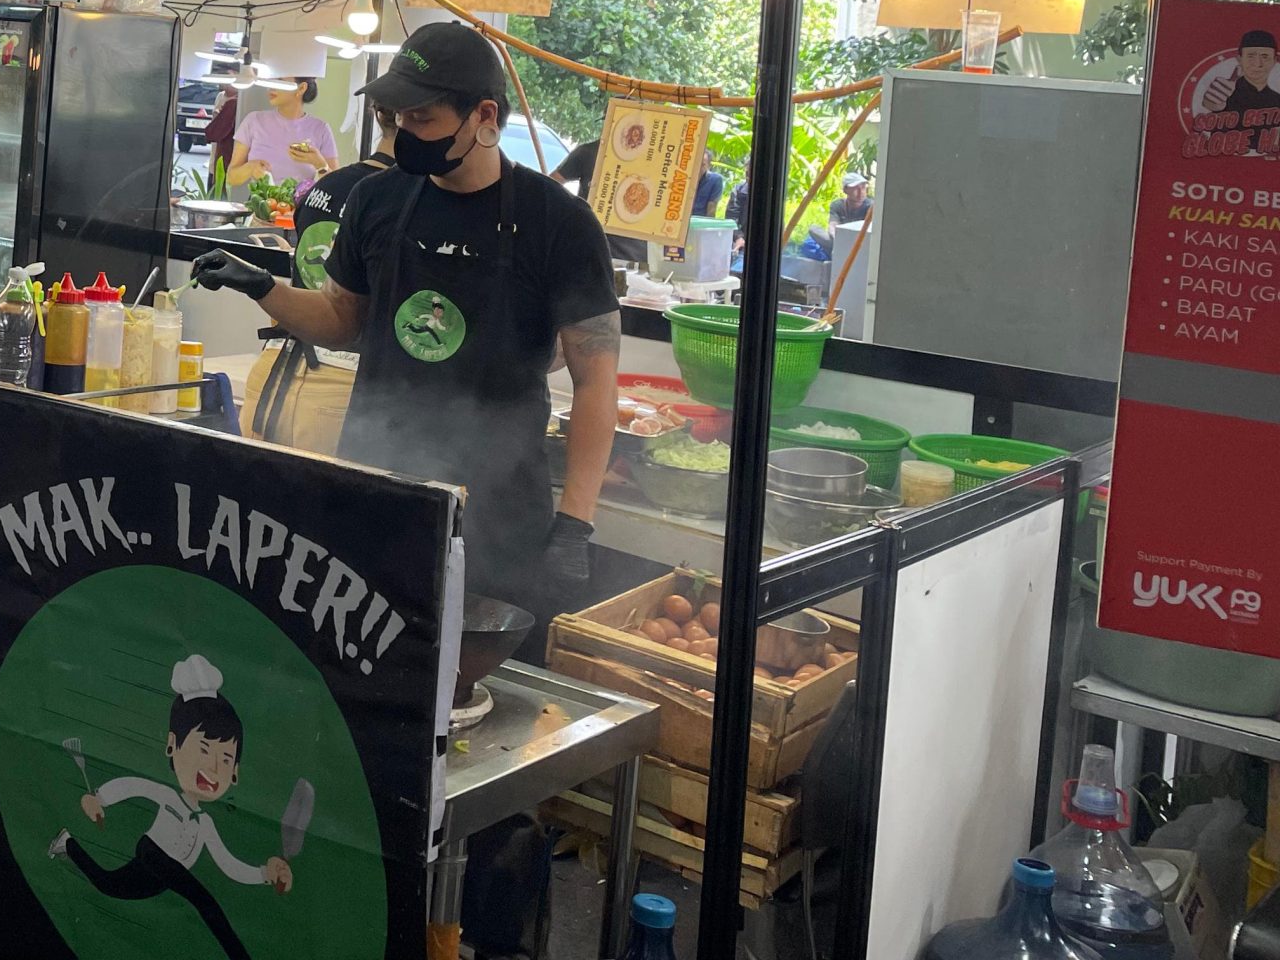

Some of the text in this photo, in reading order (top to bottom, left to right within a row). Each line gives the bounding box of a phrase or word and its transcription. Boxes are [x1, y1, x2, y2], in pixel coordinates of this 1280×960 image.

[687, 119, 699, 143] Nasi
[1193, 111, 1240, 132] SOTO
[1182, 129, 1255, 158] GLOBE
[654, 144, 676, 208] Daftar Menu
[304, 187, 332, 213] MAK..
[665, 170, 688, 221] AWENG
[1171, 181, 1244, 205] SOTO
[1168, 205, 1234, 226] KUAH
[1184, 229, 1280, 255] KAKI SA
[1182, 252, 1273, 278] DAGING
[1179, 275, 1280, 302] PARU (G
[1177, 298, 1256, 323] BABAT
[1174, 322, 1239, 345] AYAM
[174, 481, 407, 676] LAPER!!
[1137, 550, 1264, 581] Support Payment By
